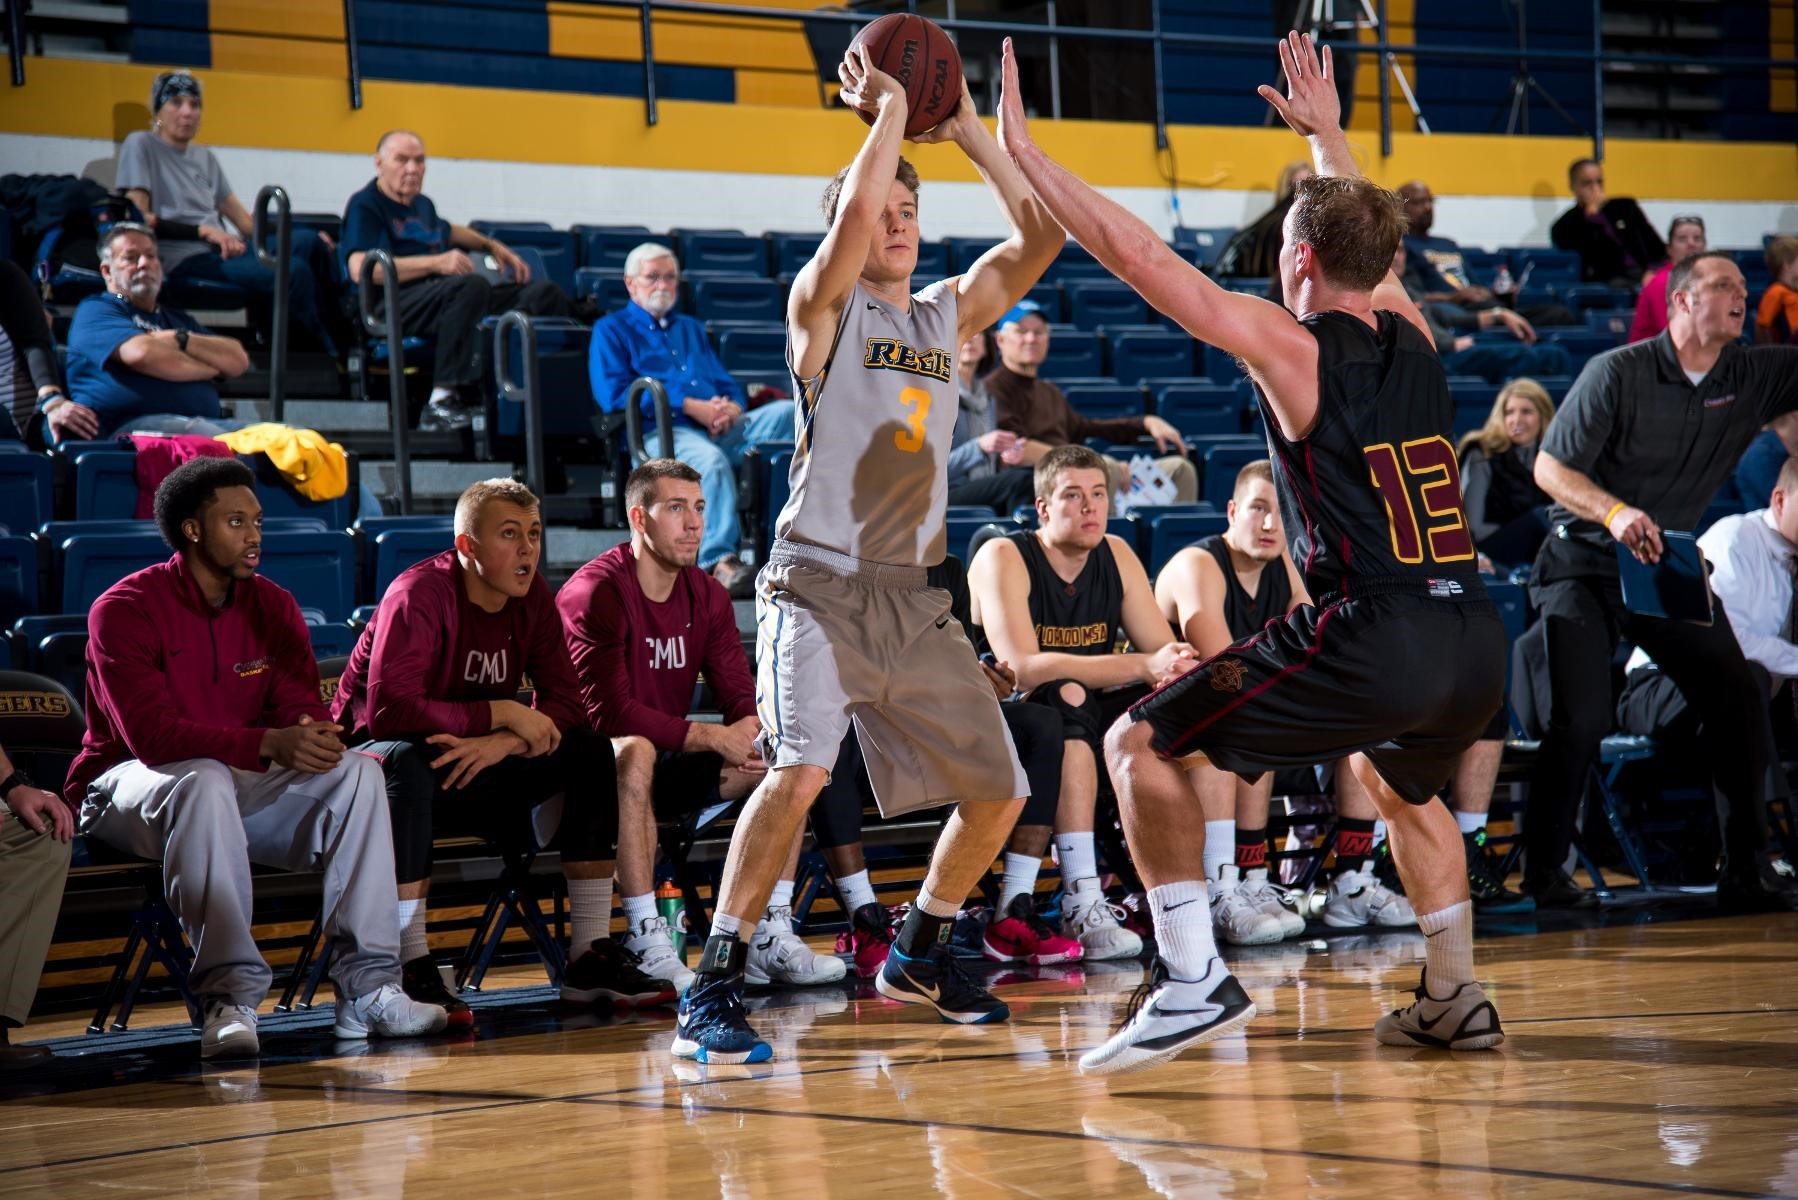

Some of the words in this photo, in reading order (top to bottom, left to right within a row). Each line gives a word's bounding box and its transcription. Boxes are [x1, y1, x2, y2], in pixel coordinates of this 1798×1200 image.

[924, 59, 948, 115] NCAA
[864, 338, 951, 383] REGIS
[895, 386, 931, 453] 3
[1364, 435, 1474, 563] 13
[464, 649, 507, 684] CMU
